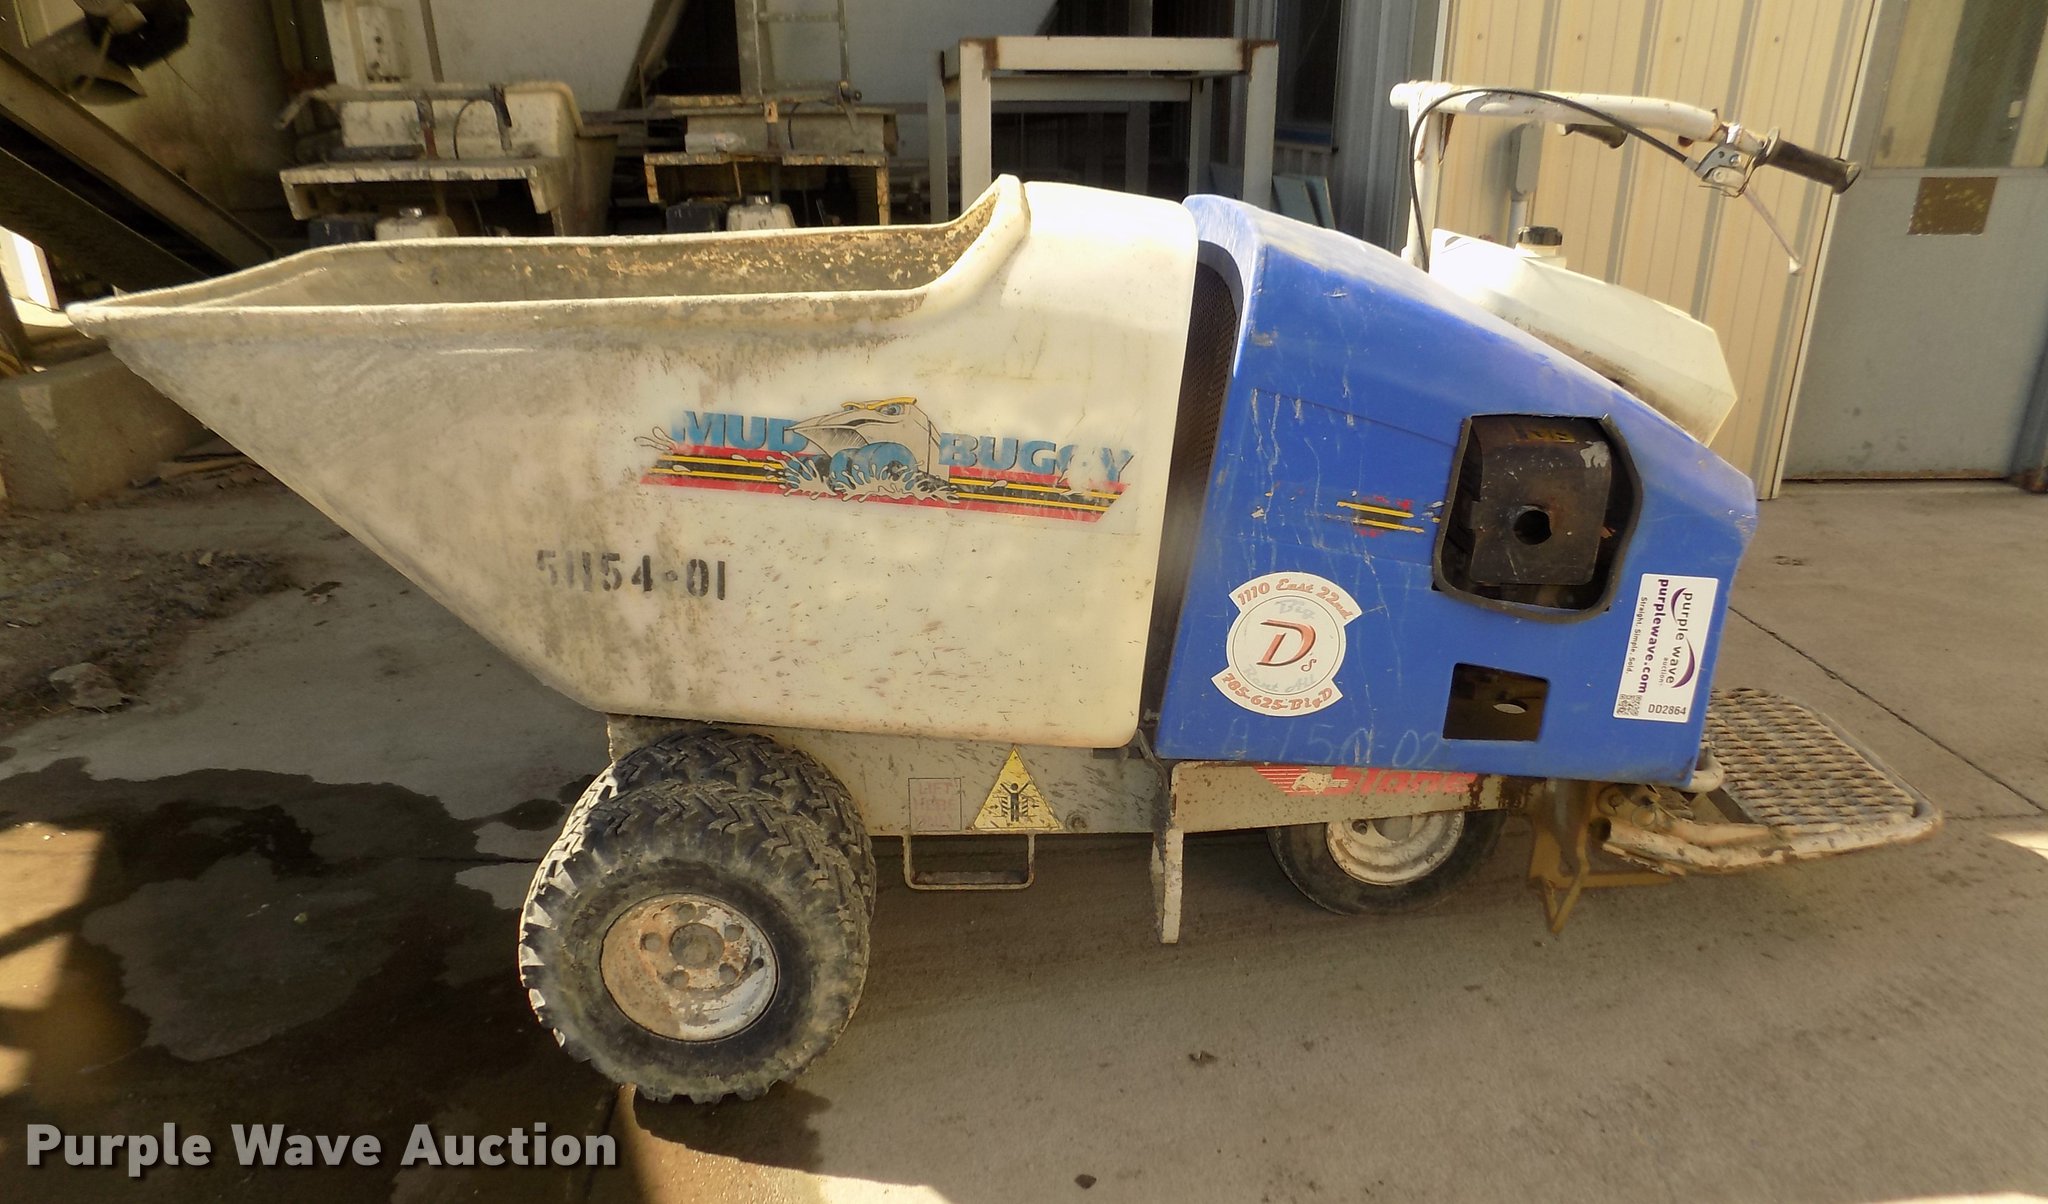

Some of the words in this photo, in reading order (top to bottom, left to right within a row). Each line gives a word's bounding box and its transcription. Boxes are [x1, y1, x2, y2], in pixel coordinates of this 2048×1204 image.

[671, 410, 809, 453] MUD
[1237, 582, 1271, 606] 1110
[1276, 578, 1315, 594] East
[1316, 586, 1354, 620] 22nd
[1675, 592, 1694, 642] purple
[1637, 578, 1669, 694] purplewave.com
[1665, 646, 1682, 684] wave
[1647, 703, 1687, 715] DD2864
